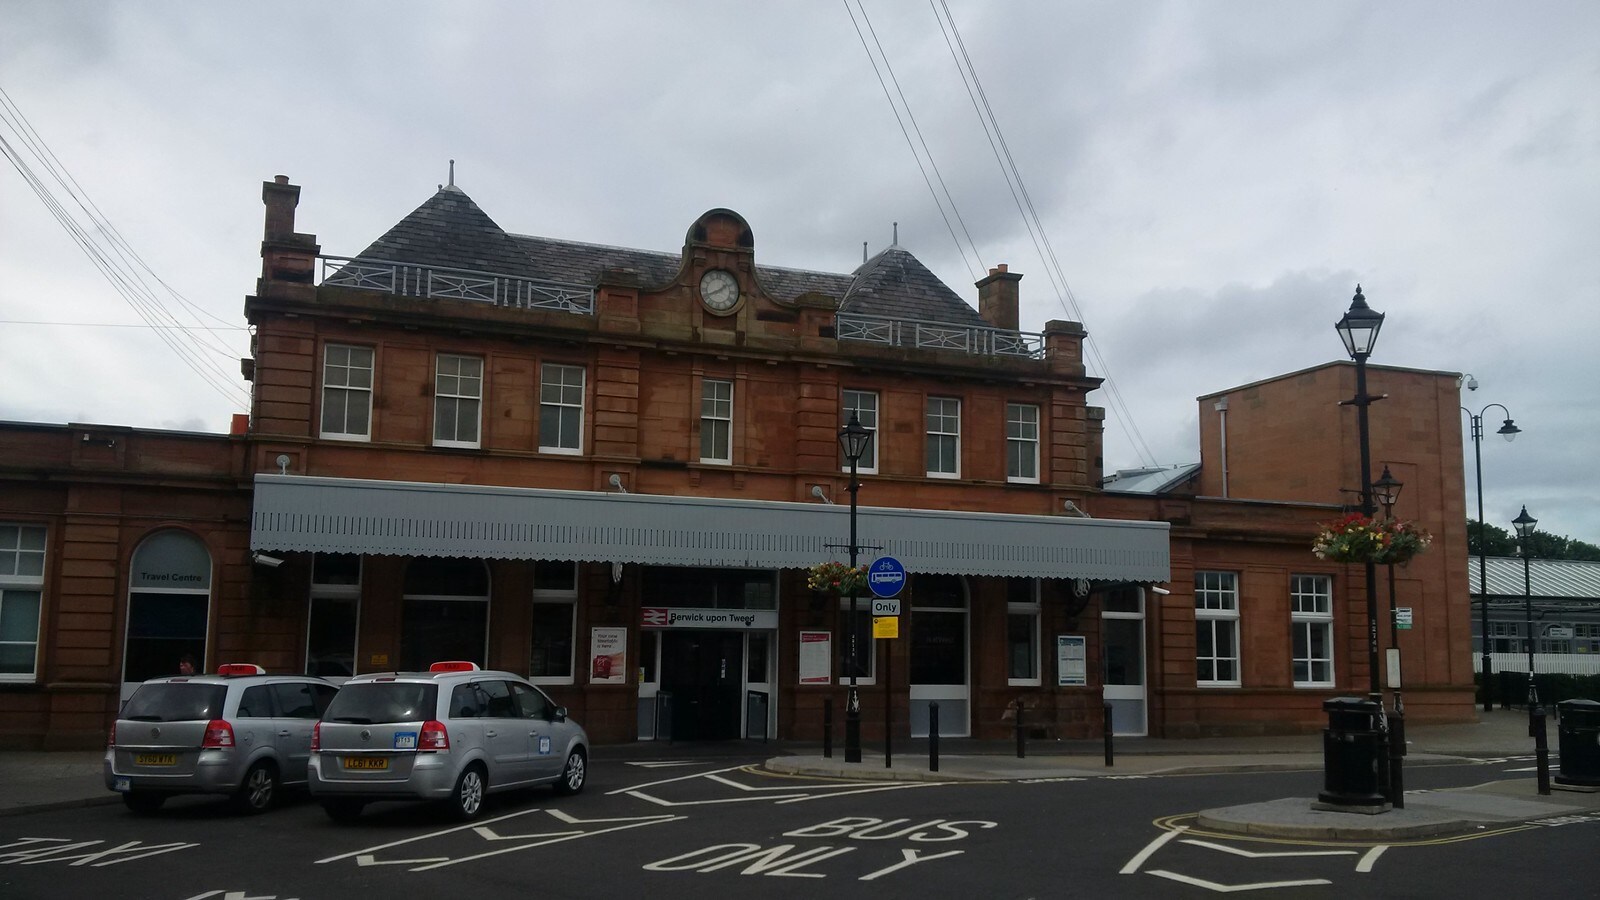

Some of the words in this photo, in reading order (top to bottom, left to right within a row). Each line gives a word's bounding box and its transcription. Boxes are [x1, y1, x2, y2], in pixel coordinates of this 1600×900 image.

[141, 572, 169, 581] Travel
[171, 573, 202, 582] Centre
[875, 602, 897, 613] Only
[670, 612, 704, 622] Berwick
[706, 614, 727, 623] upon
[729, 613, 755, 623] Tweed
[783, 816, 998, 842] BUS
[642, 843, 966, 881] ONLY
